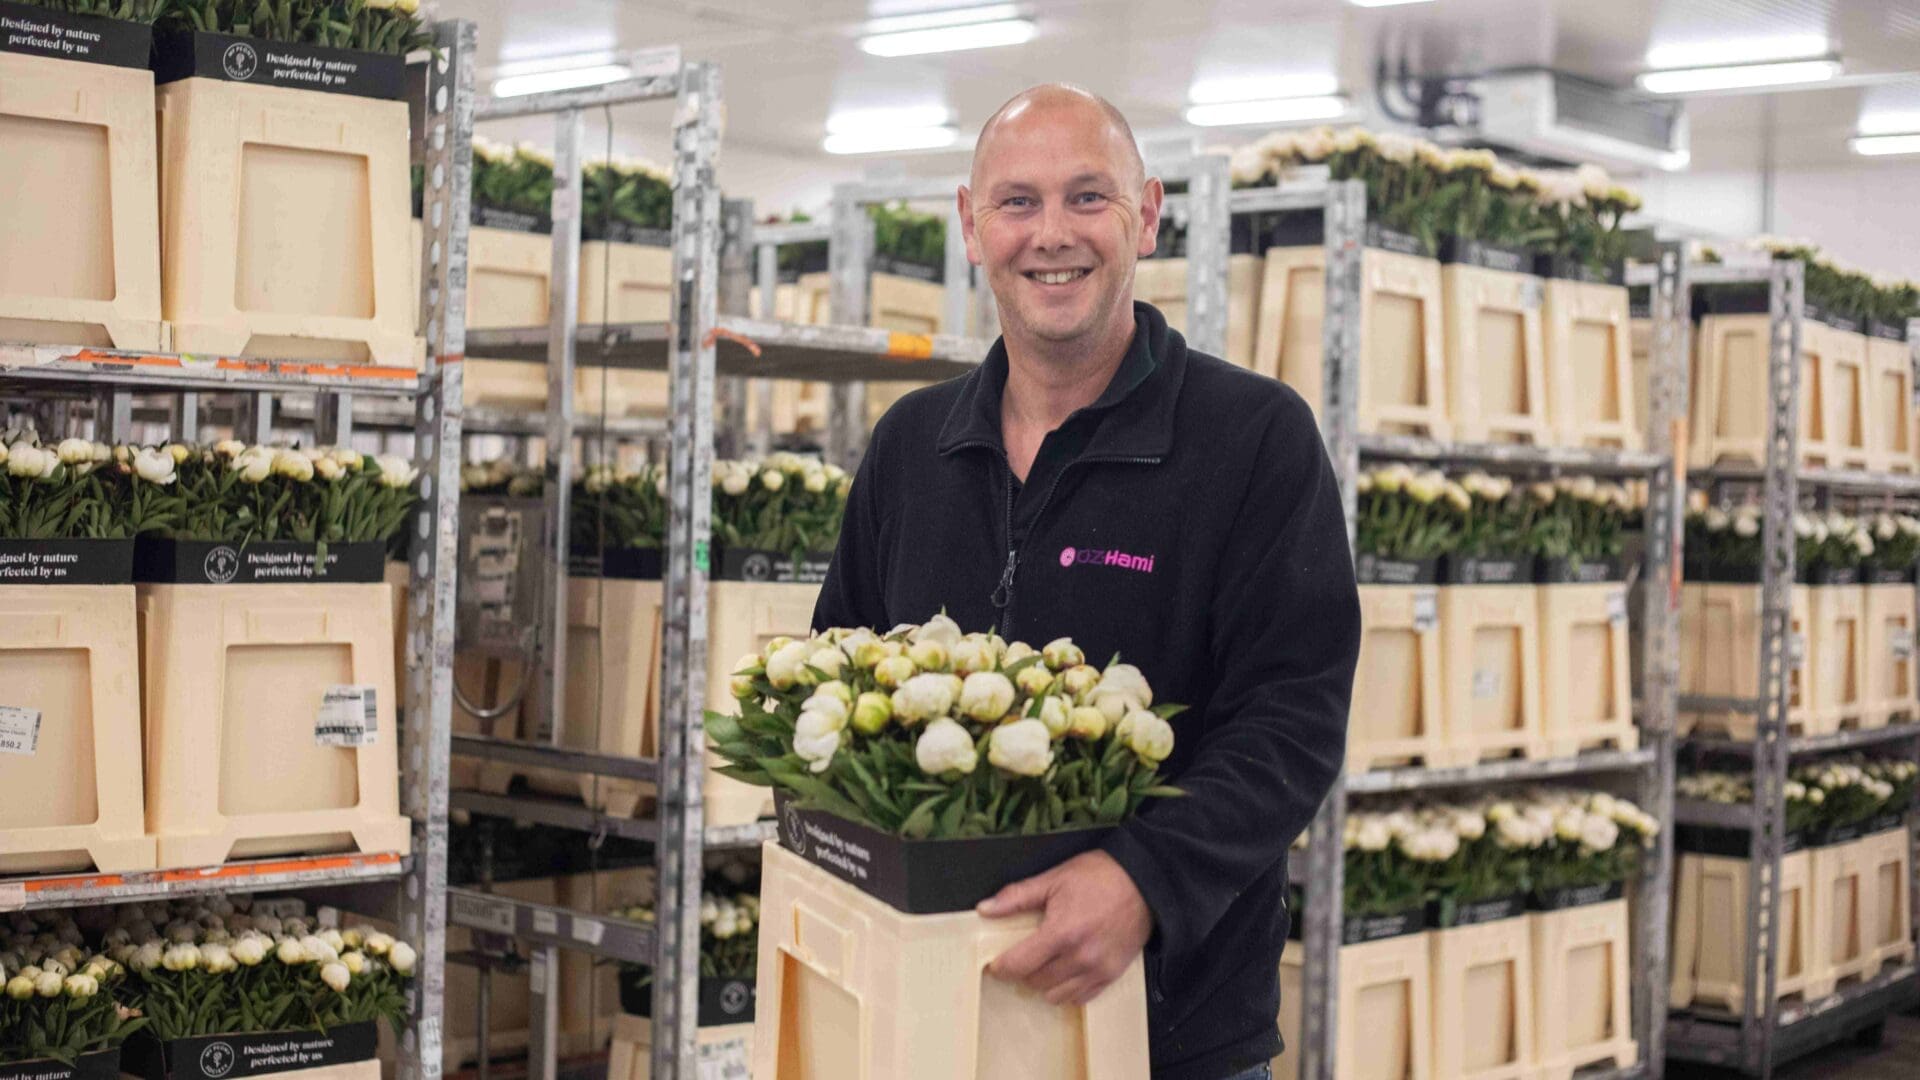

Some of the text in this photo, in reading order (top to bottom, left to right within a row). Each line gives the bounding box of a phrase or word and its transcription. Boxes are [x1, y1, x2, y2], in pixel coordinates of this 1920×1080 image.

[1, 17, 101, 42] Designed by nature
[8, 34, 89, 54] perfected by us
[266, 53, 357, 73] Designed by nature
[273, 68, 320, 81] perfected
[321, 71, 334, 85] by
[28, 552, 41, 565] by
[43, 553, 78, 563] nature
[248, 552, 292, 564] Designed
[293, 552, 304, 566] by
[40, 566, 53, 579] by
[54, 567, 67, 577] us
[254, 566, 301, 578] perfected
[302, 565, 313, 578] by
[243, 1039, 335, 1056] Designed by nature
[250, 1051, 323, 1068] perfected by us
